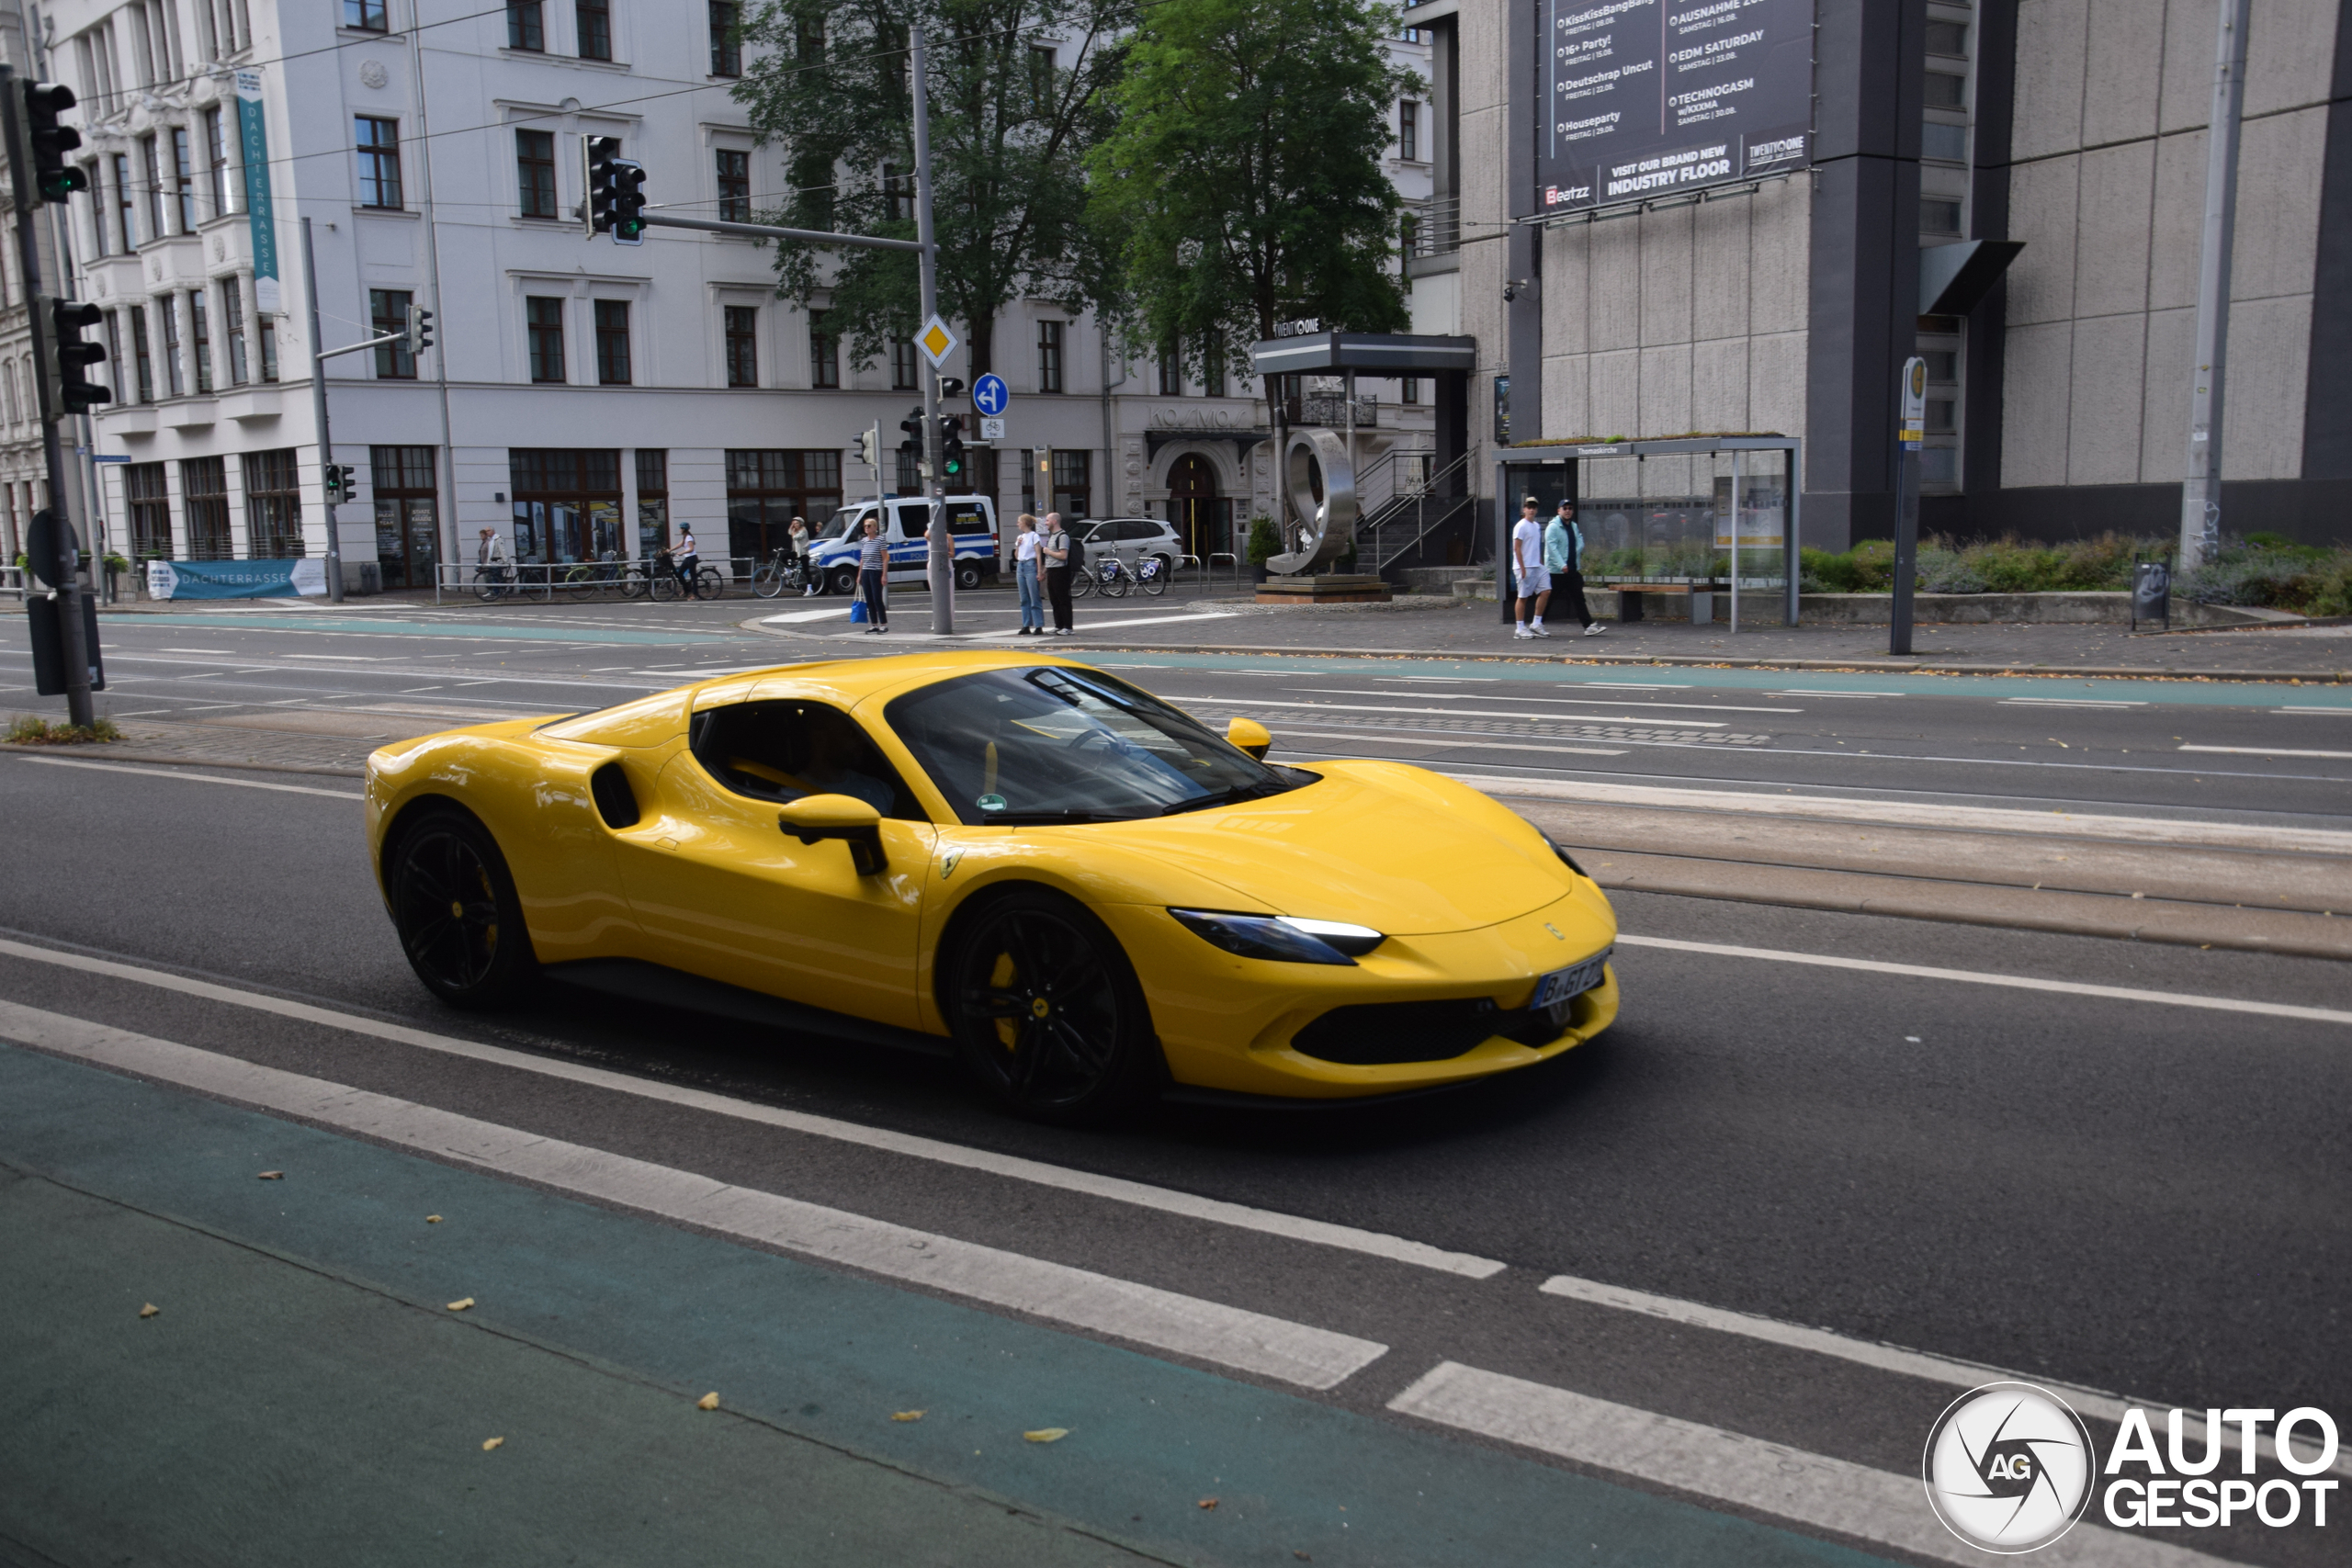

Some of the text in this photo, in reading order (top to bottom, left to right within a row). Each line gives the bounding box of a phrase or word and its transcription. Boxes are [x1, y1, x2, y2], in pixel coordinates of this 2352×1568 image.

[1679, 0, 1740, 24] AUSNAHME
[1565, 23, 1591, 36] FREITAG
[1596, 17, 1616, 28] 08.08.
[1679, 20, 1713, 35] SAMSTAG
[1717, 13, 1737, 24] 16.08.
[1565, 35, 1611, 55] 16+ Party!
[1679, 29, 1764, 62] EDM SATURDAY
[1565, 53, 1591, 66] FREITAG
[1596, 48, 1614, 58] 15.08.
[1678, 58, 1711, 73] SAMSTAG
[1716, 51, 1737, 63] 23.08.
[1565, 60, 1653, 90] Deutschrap Uncut
[1565, 88, 1591, 100] FREITAG
[1596, 84, 1615, 93] 22.08.
[1678, 78, 1754, 105] TECHNOGASM
[1565, 112, 1621, 131] Houseparty
[1678, 112, 1711, 126] SAMSTAG
[1715, 107, 1736, 118] 30.08.
[1565, 130, 1591, 141] FREITAG
[1596, 125, 1615, 135] 29.08.
[1611, 144, 1727, 177] VISIT OUR BRAND NEW
[1608, 159, 1730, 196] INDUSTRY FLOOR
[247, 107, 270, 272] DACHTERRASSE
[1546, 186, 1589, 205] Beatzz
[1148, 406, 1246, 428] KOSMOS
[1577, 446, 1618, 456] Thomaskirche
[183, 573, 287, 584] DACHTERRASSE
[1544, 976, 1559, 1003] B
